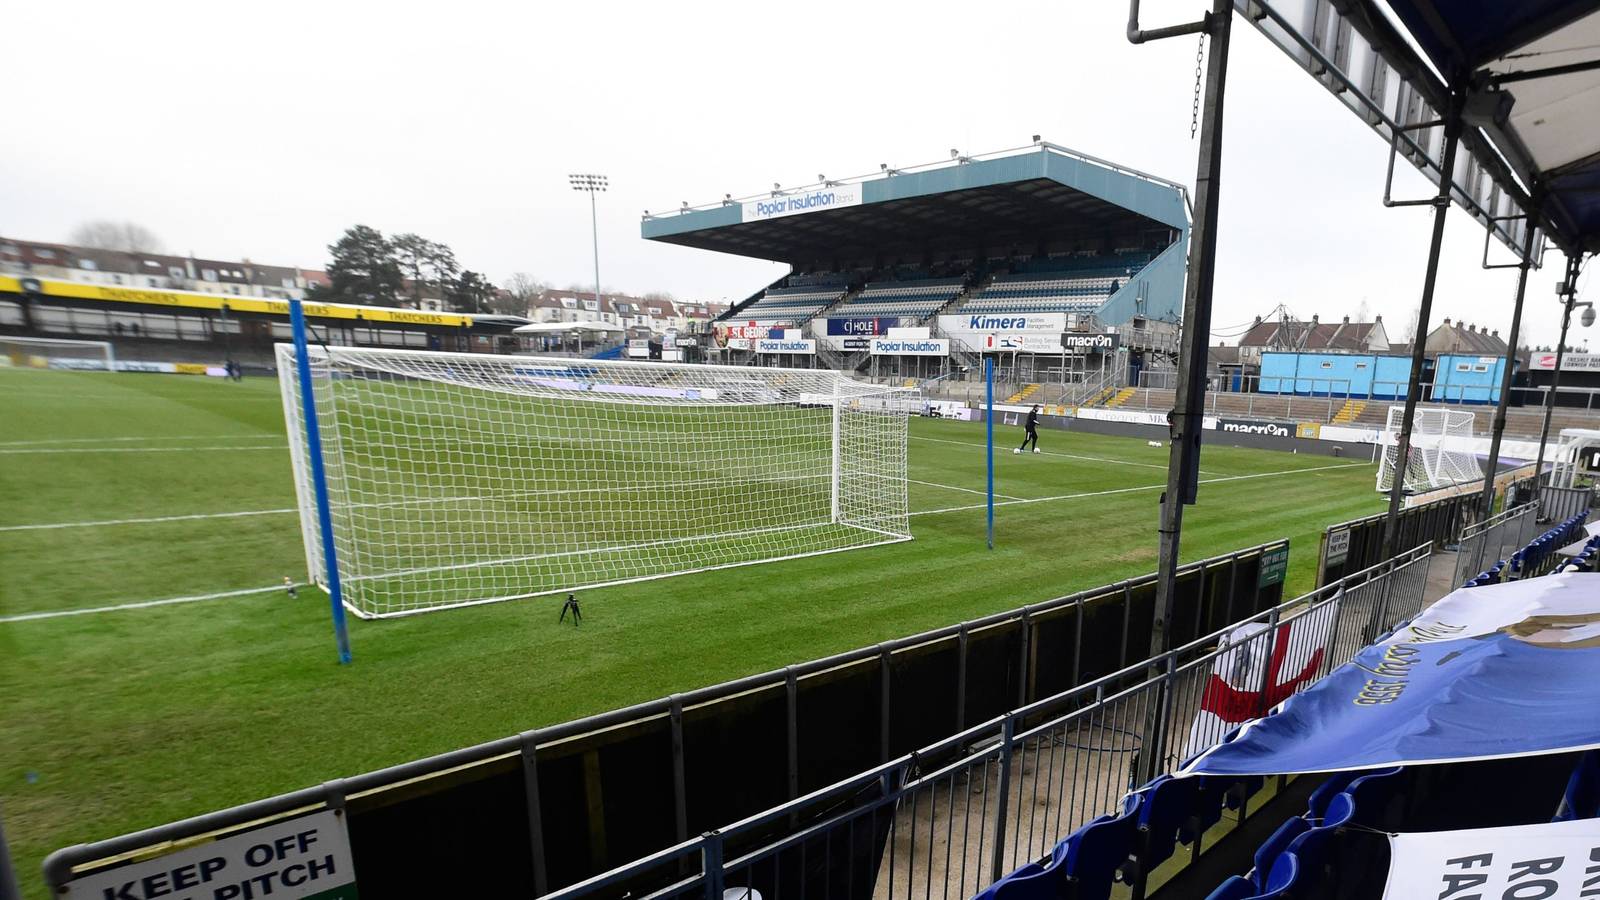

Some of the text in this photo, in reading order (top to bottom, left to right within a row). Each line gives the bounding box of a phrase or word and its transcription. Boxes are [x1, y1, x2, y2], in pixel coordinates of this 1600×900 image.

[757, 200, 786, 217] Poplar
[788, 192, 835, 211] Insulation
[267, 301, 328, 315] THAHERS
[389, 311, 442, 323] THATCHERS
[970, 315, 1026, 329] Kimera
[853, 321, 873, 332] HOLE
[760, 341, 778, 352] Poplar
[780, 340, 809, 350] Insulation
[876, 341, 941, 354] Poplar Insulation
[1067, 334, 1112, 347] macron
[1223, 422, 1289, 437] macron
[102, 829, 319, 900] KEEP OFF
[214, 854, 335, 900] PITCH
